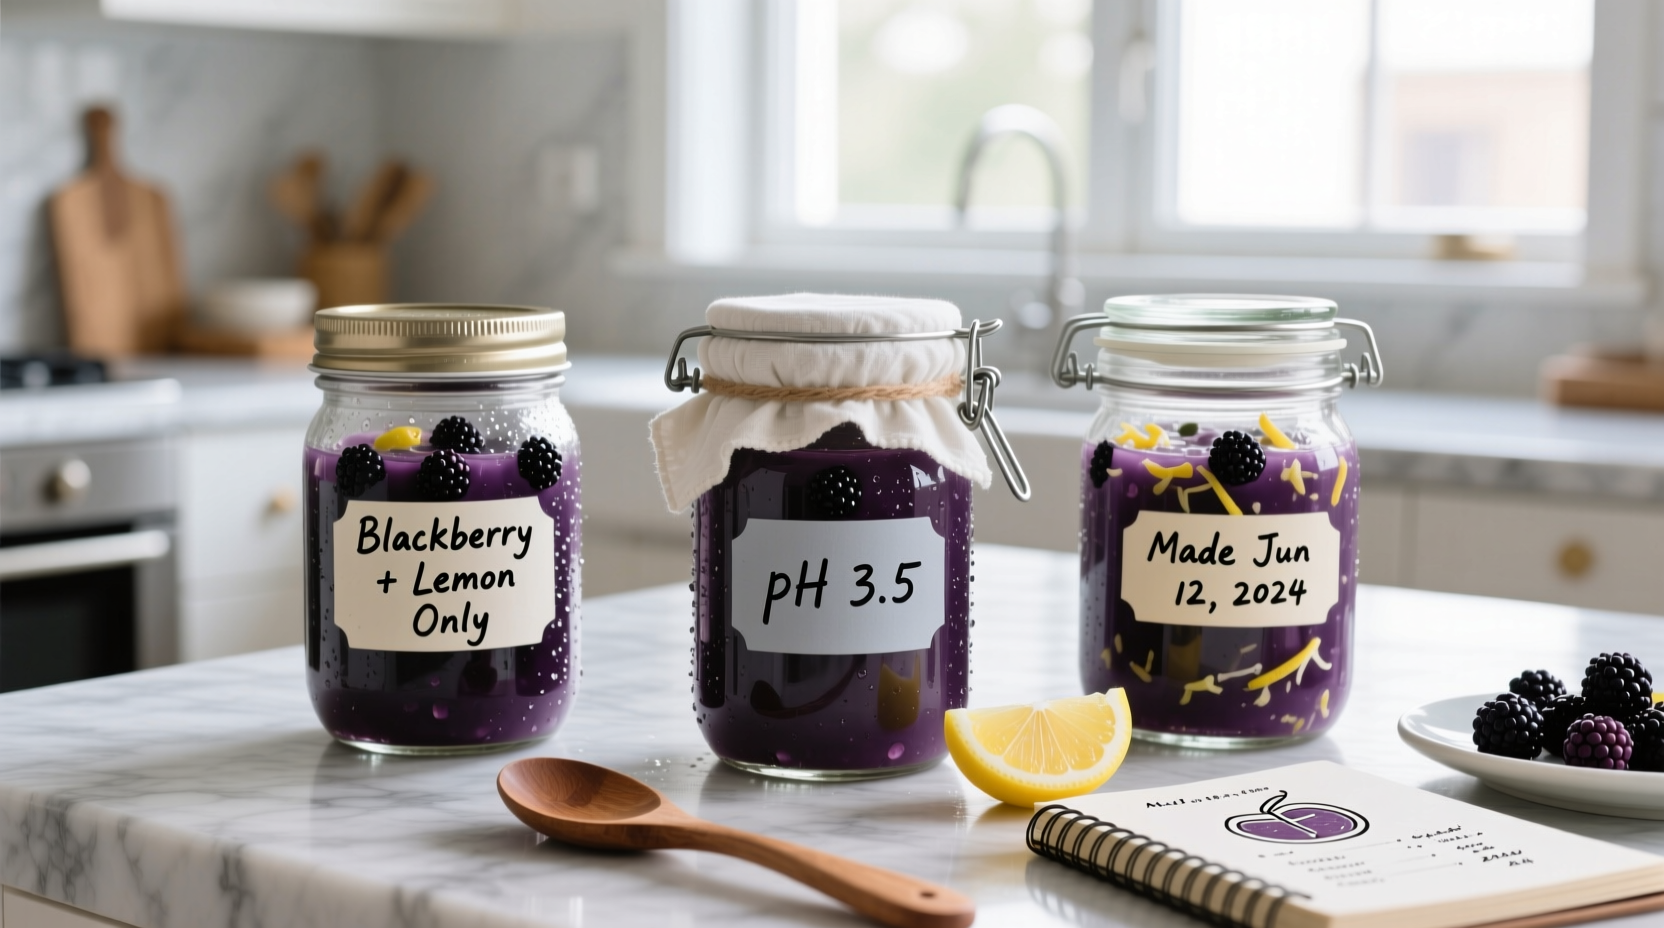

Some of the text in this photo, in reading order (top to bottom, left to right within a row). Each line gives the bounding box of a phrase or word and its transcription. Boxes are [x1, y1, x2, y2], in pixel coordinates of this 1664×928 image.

[356, 515, 533, 560] Blackberry
[1146, 530, 1311, 568] Made Jun
[376, 560, 516, 597] + Lemon
[762, 557, 922, 625] pH 3.5
[1174, 578, 1307, 614] 12, 2024
[411, 600, 490, 647] Only
